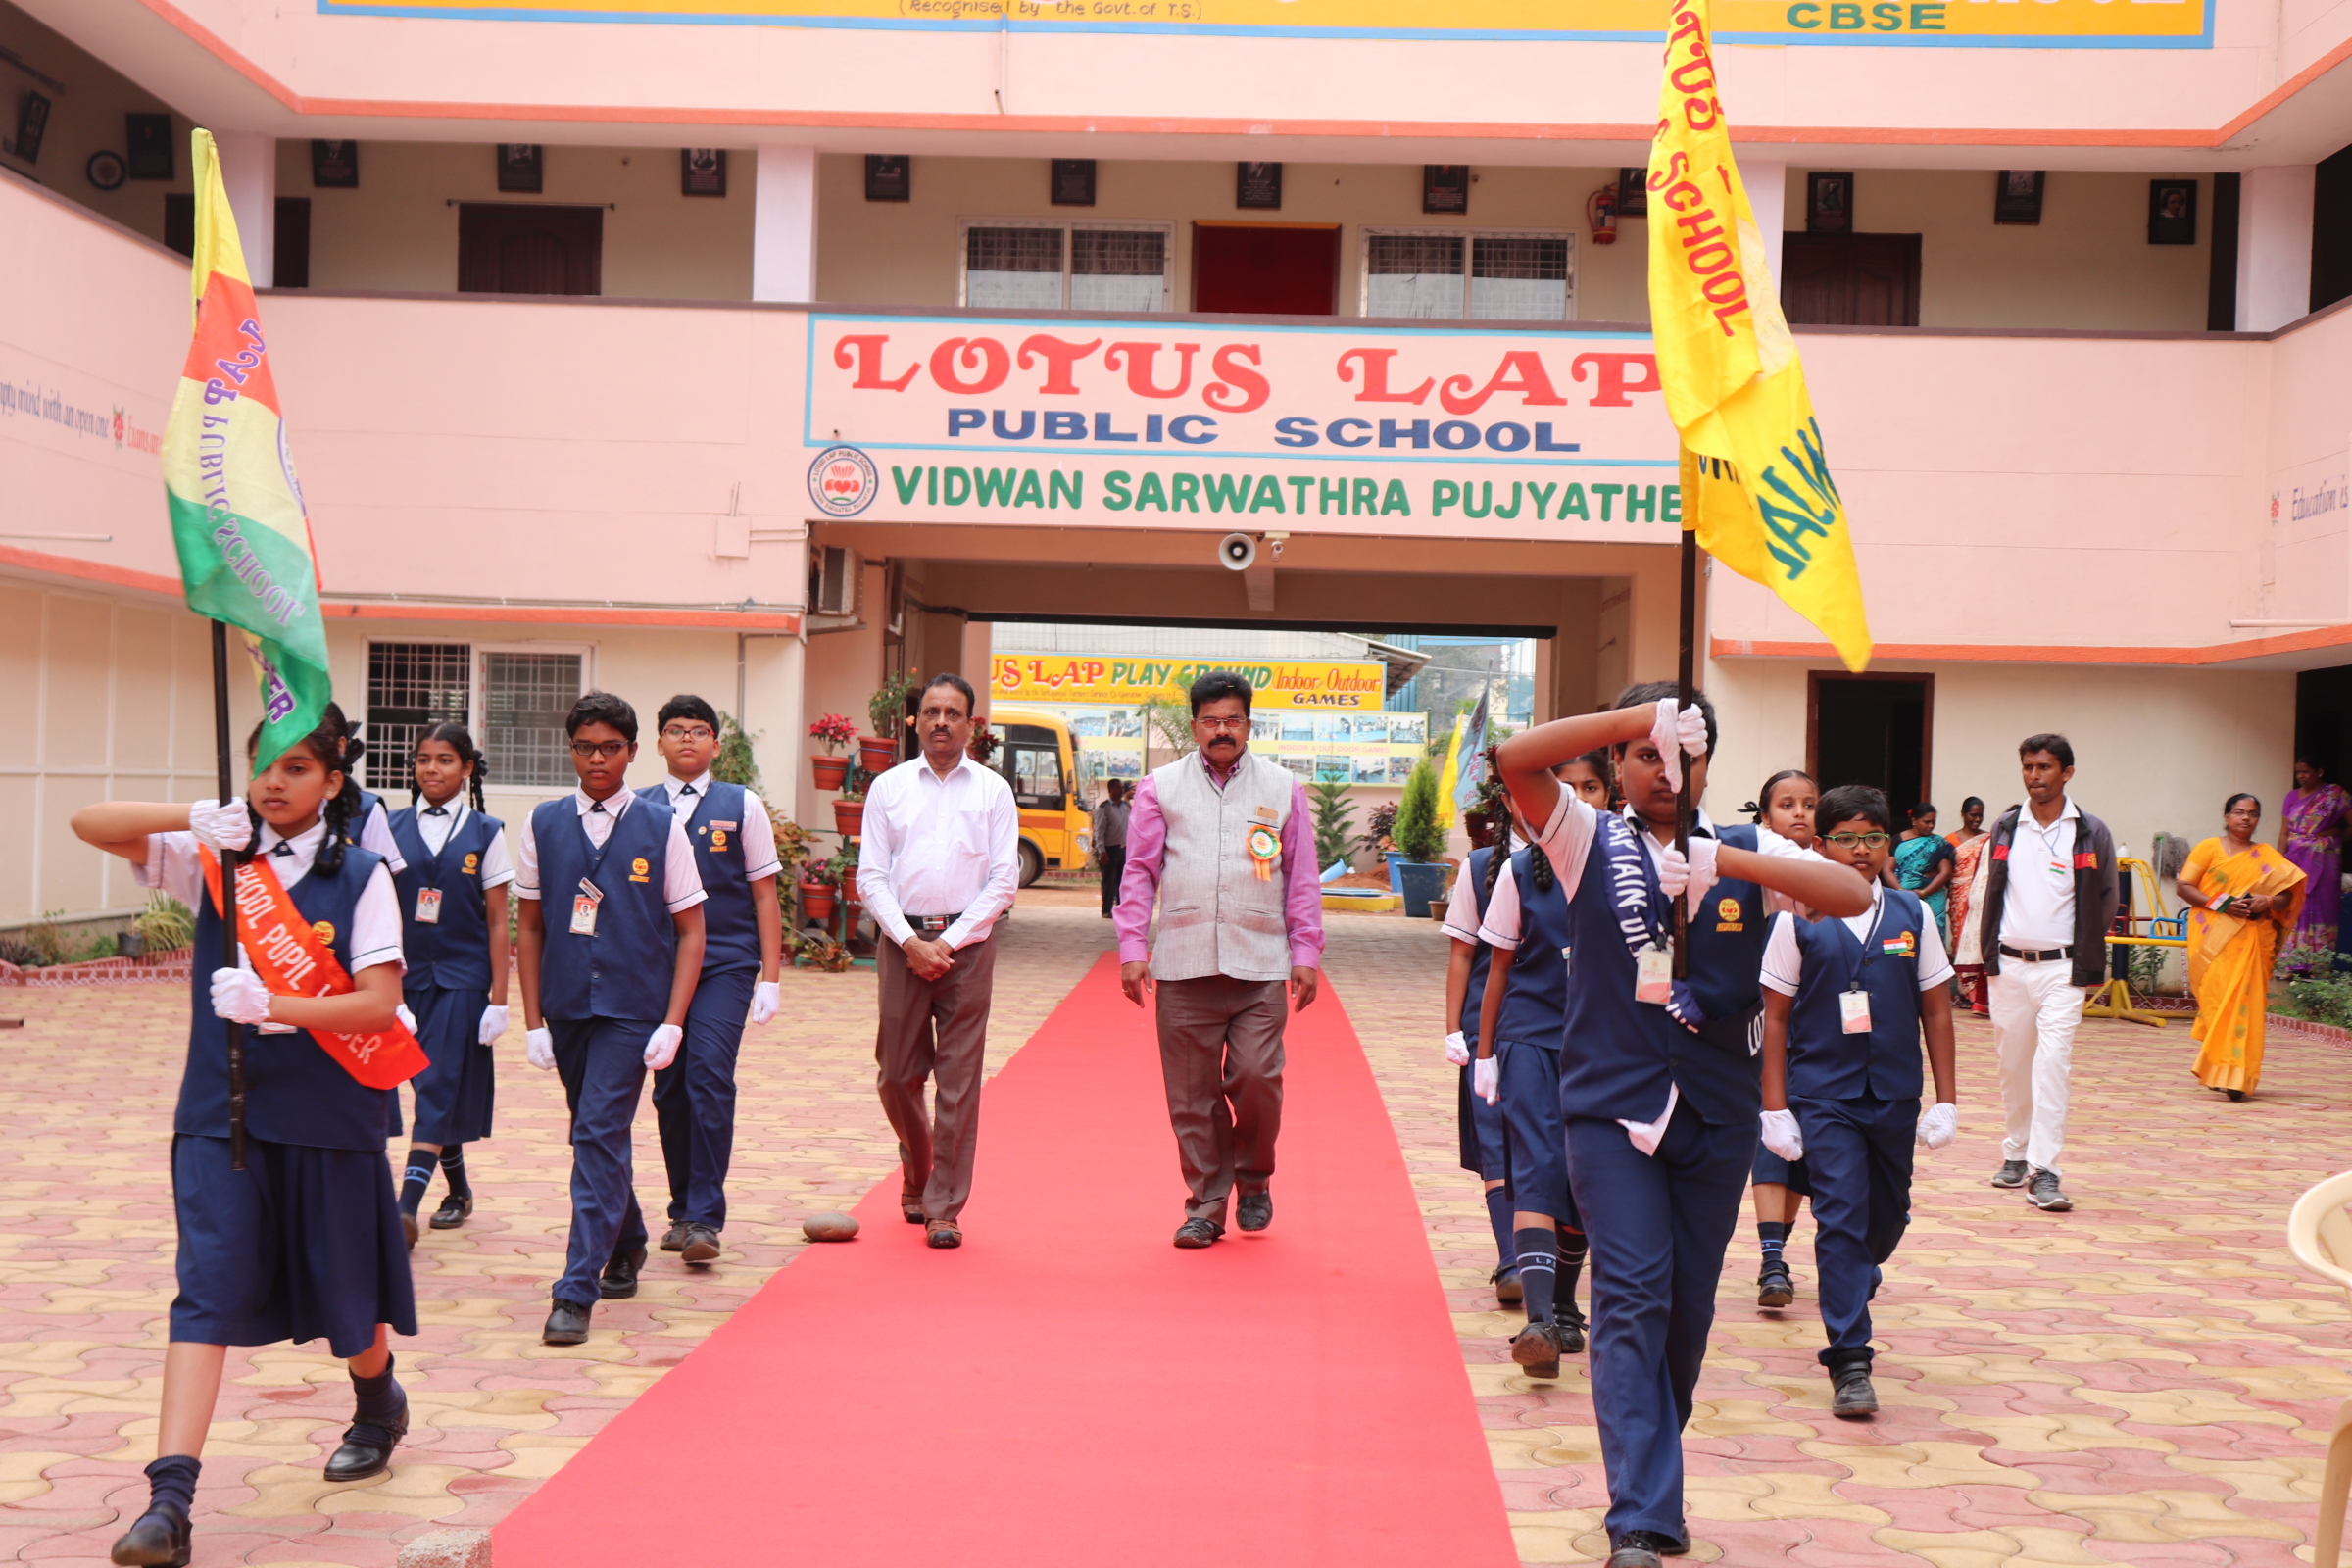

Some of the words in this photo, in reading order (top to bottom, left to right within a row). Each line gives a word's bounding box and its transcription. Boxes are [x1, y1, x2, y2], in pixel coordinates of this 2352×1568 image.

[1019, 0, 1040, 17] by
[1056, 0, 1085, 16] the
[1139, 2, 1157, 16] of
[1787, 3, 1946, 30] CBSE
[1646, 151, 1749, 337] SCHOOL
[833, 331, 1272, 413] LOTUS
[1337, 348, 1663, 415] LAP
[18, 379, 40, 416] mind
[42, 388, 61, 423] with
[63, 403, 74, 429] an
[75, 408, 94, 439] open
[948, 408, 1219, 445] PUBLIC
[1274, 416, 1581, 453] SCHOOL
[891, 465, 1083, 512] VIDWAN
[1102, 470, 1411, 517] SARWATHRA
[1432, 480, 1682, 524] PUJYATHE
[2292, 479, 2336, 521] Education
[2339, 474, 2349, 508] is
[1028, 660, 1105, 688] LAP
[1110, 662, 1173, 686] PLAY
[1293, 693, 1360, 706] GAMES
[257, 922, 317, 992] PUPIL
